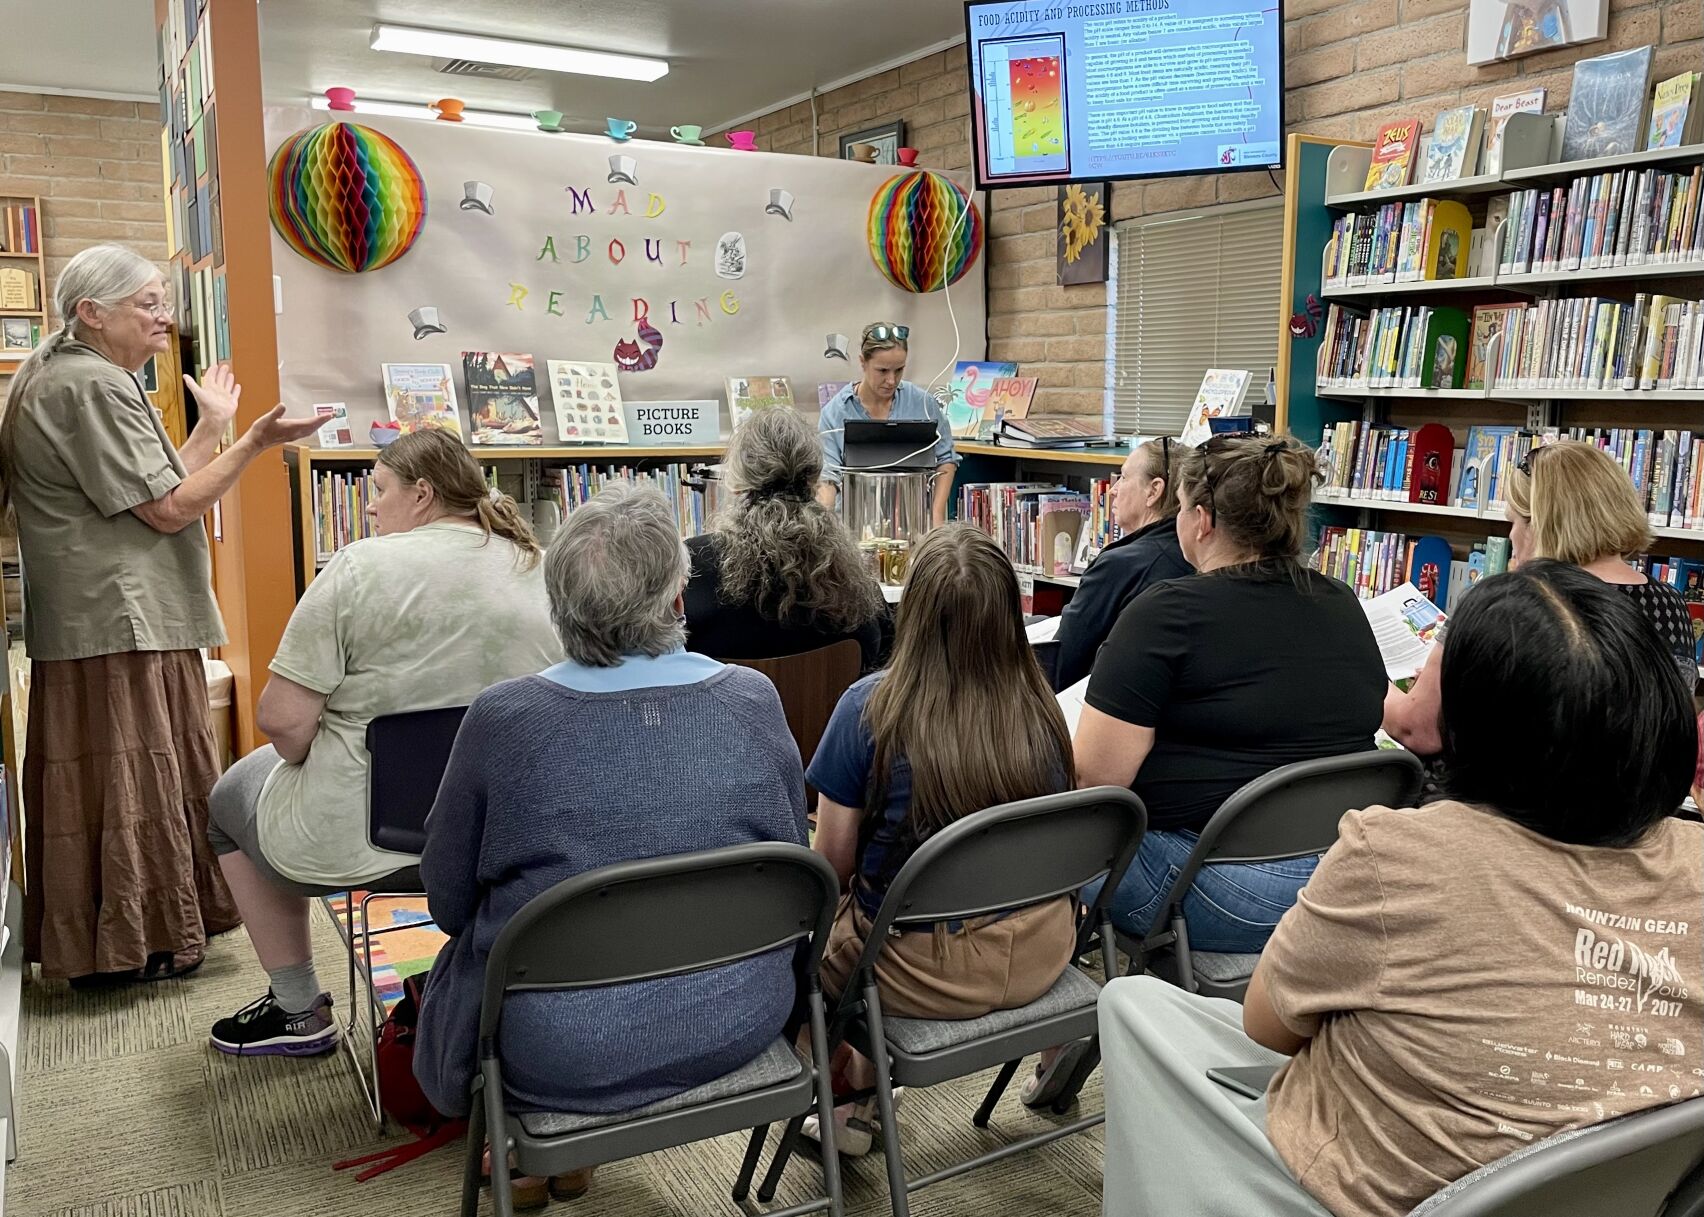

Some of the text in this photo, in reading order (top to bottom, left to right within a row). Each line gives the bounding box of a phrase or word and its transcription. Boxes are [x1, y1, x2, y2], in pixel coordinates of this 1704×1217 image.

[978, 0, 1170, 27] FOOD ACIDITY AND PROCESSING METHODS
[1495, 97, 1539, 112] Dear Beast
[1382, 124, 1411, 147] ZEUS
[565, 186, 666, 218] MAD
[536, 235, 691, 267] ABOUT
[506, 282, 741, 328] READING
[636, 408, 700, 421] PICTURE
[643, 423, 693, 435] BOOKS
[1644, 919, 1689, 935] GEAR
[1575, 927, 1625, 972] Red
[1575, 989, 1683, 1017] Mar 24-27 2017
[285, 1021, 306, 1032] AIR
[1553, 1053, 1600, 1067] Black Diamond
[1631, 1062, 1663, 1073] CAMP
